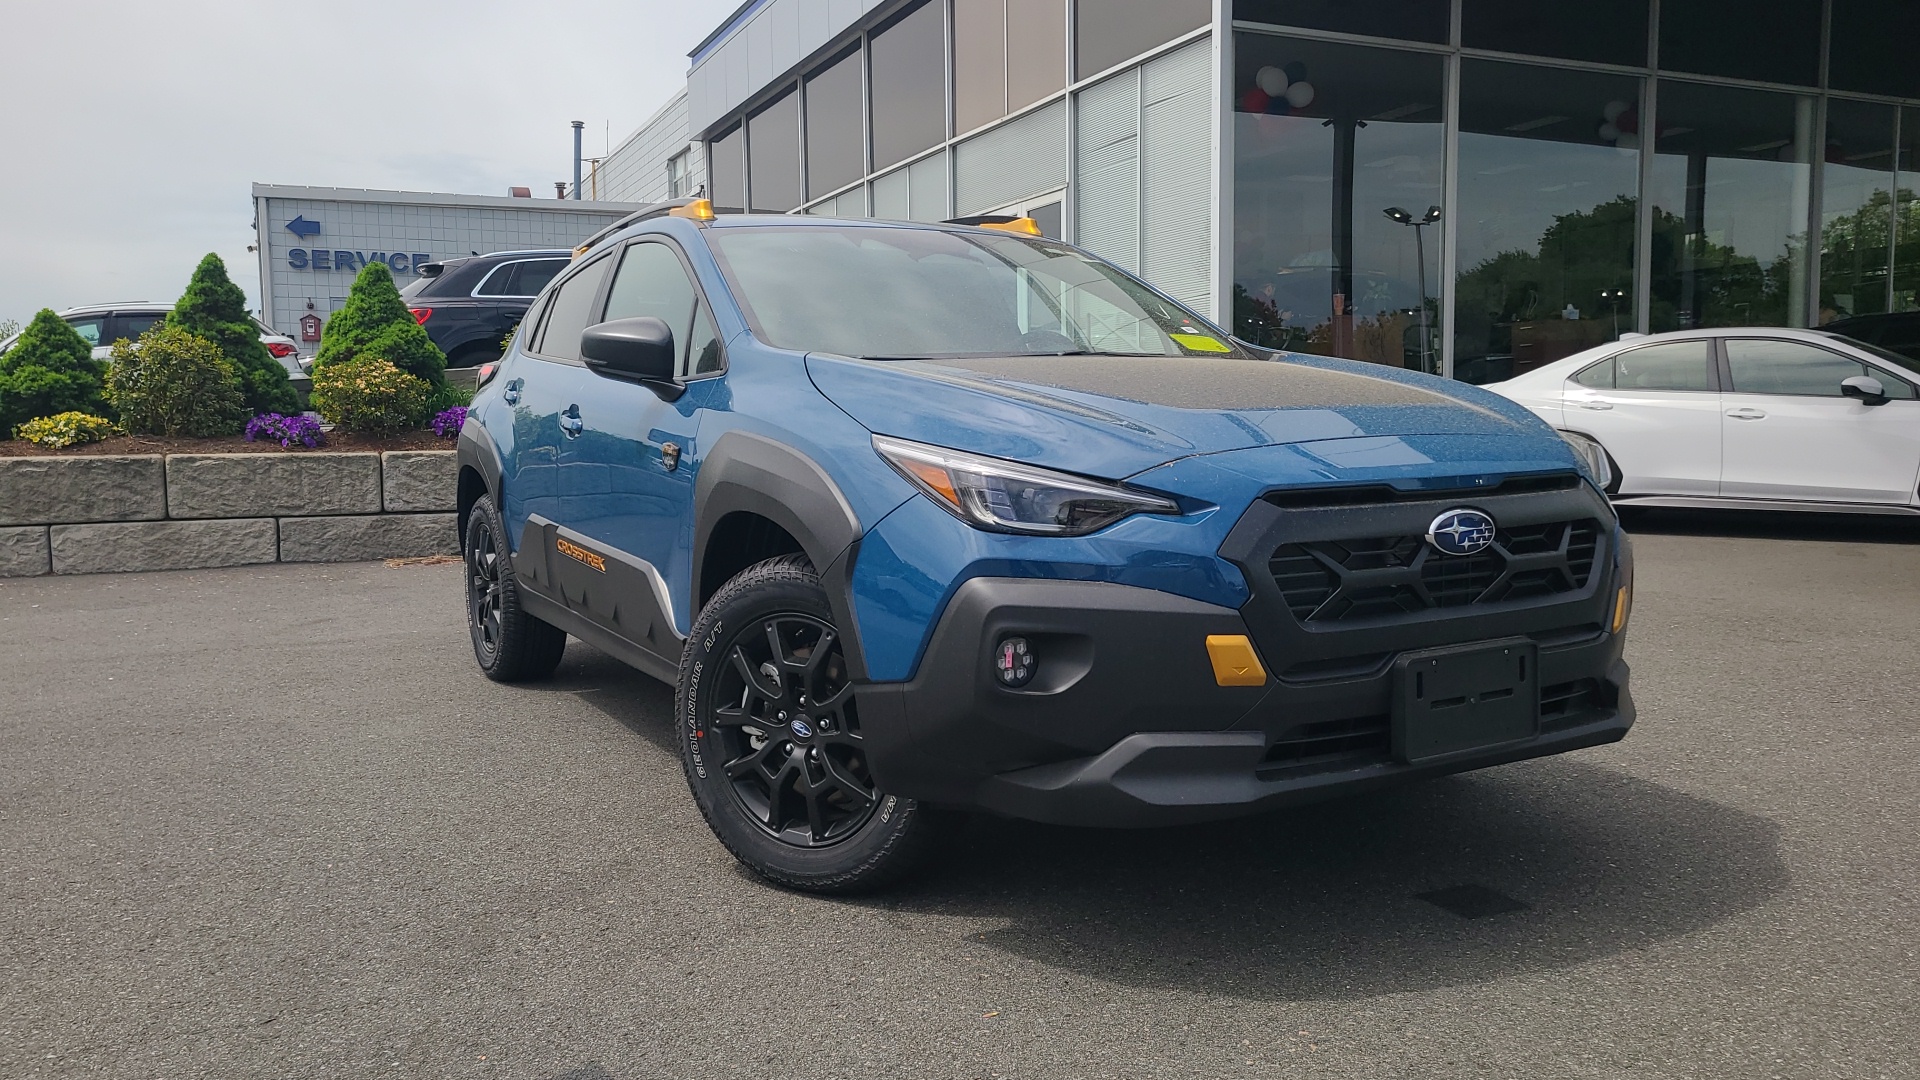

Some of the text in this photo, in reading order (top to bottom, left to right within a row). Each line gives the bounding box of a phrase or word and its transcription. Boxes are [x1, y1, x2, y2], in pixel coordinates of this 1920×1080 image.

[288, 248, 430, 275] SERVICE
[557, 539, 606, 572] CROSSTREK
[687, 620, 723, 779] GEOLANDAR A/T
